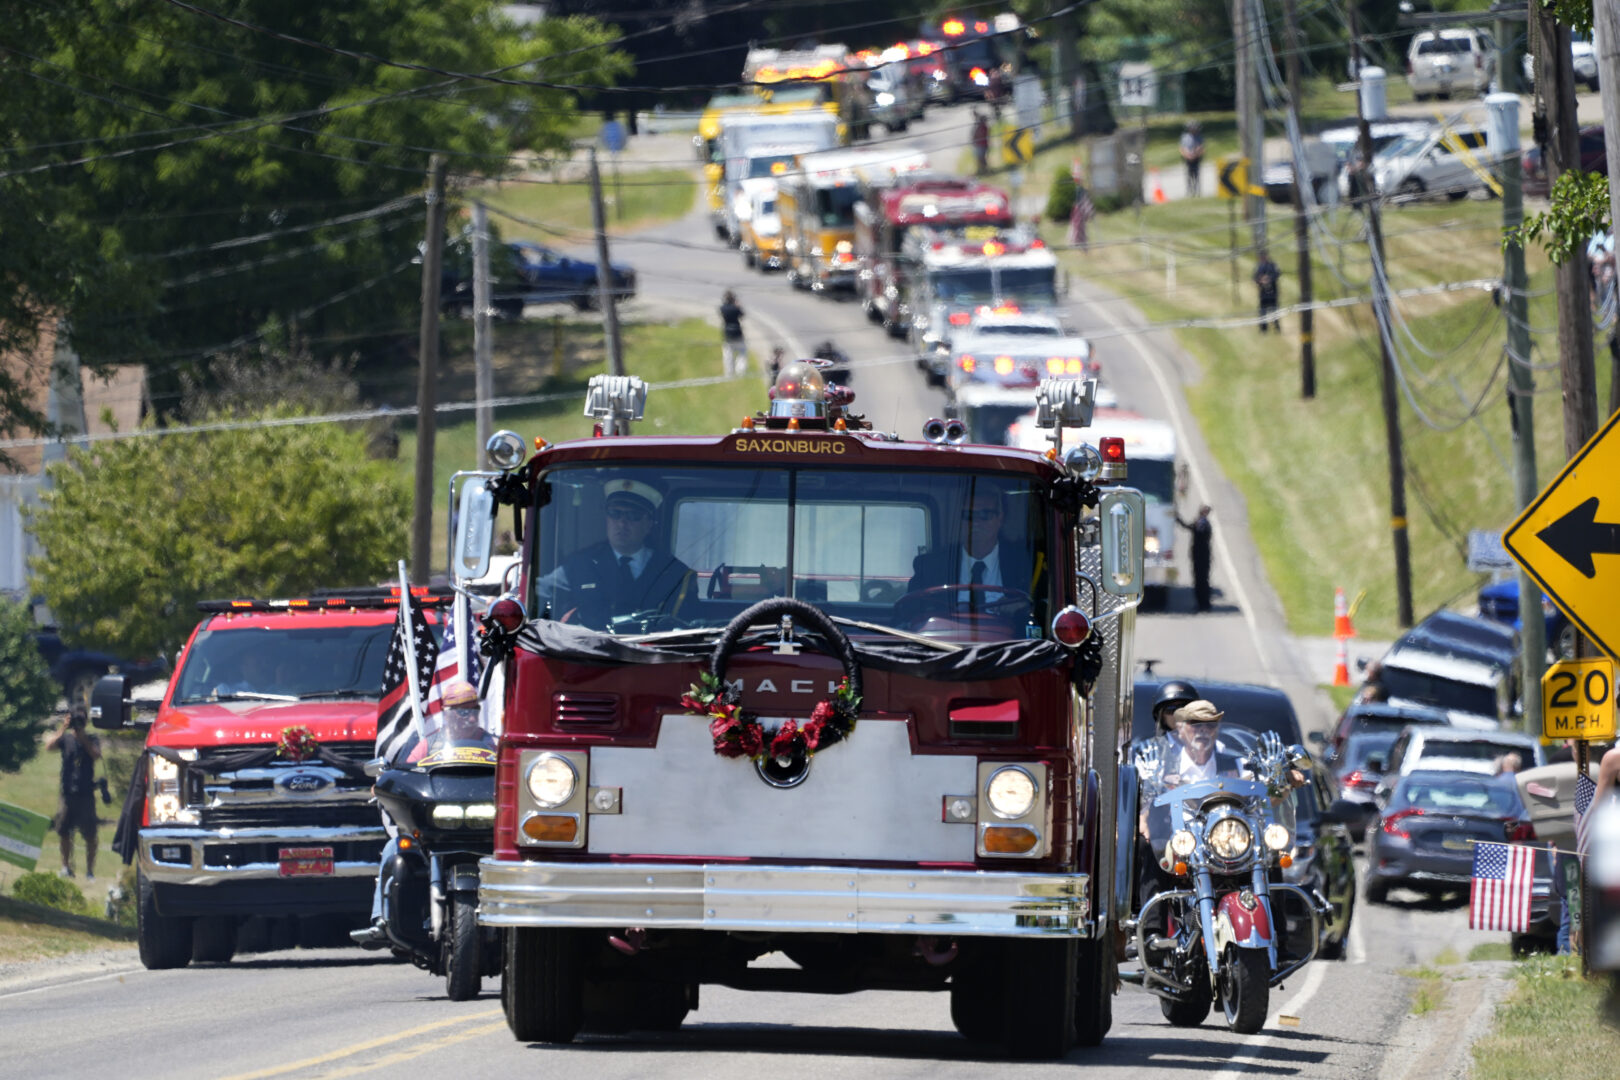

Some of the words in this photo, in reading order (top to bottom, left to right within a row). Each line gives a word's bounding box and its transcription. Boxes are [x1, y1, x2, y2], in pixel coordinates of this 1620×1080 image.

[735, 438, 846, 455] SAXONBURG
[1550, 669, 1609, 708] 20
[290, 776, 319, 790] Ford
